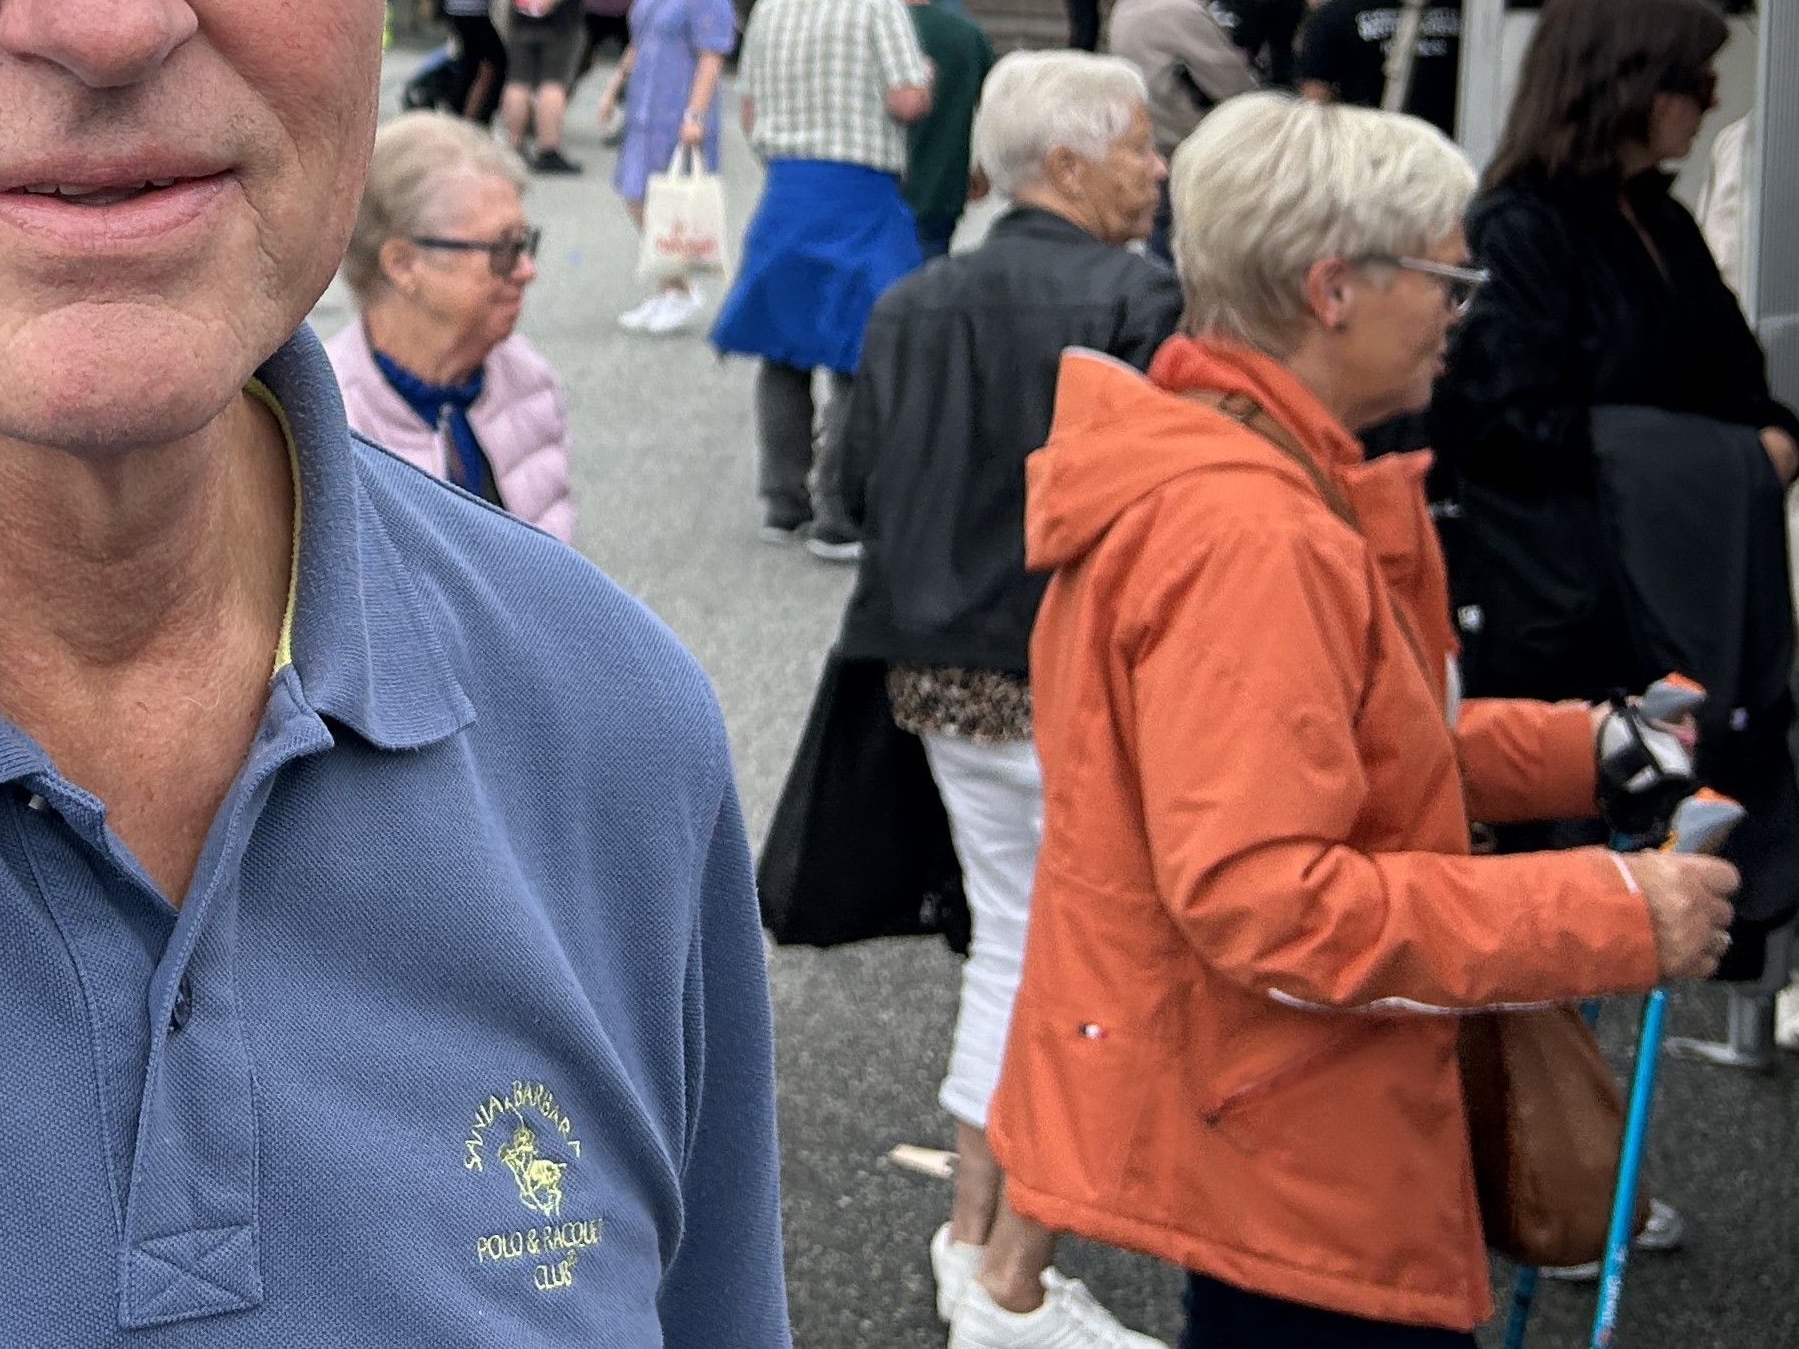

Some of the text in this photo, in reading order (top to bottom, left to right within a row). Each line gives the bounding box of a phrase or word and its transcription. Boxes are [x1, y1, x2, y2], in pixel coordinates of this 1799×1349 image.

[477, 1231, 523, 1262] POLO
[527, 1228, 541, 1254] &
[534, 1261, 572, 1290] CLUB
